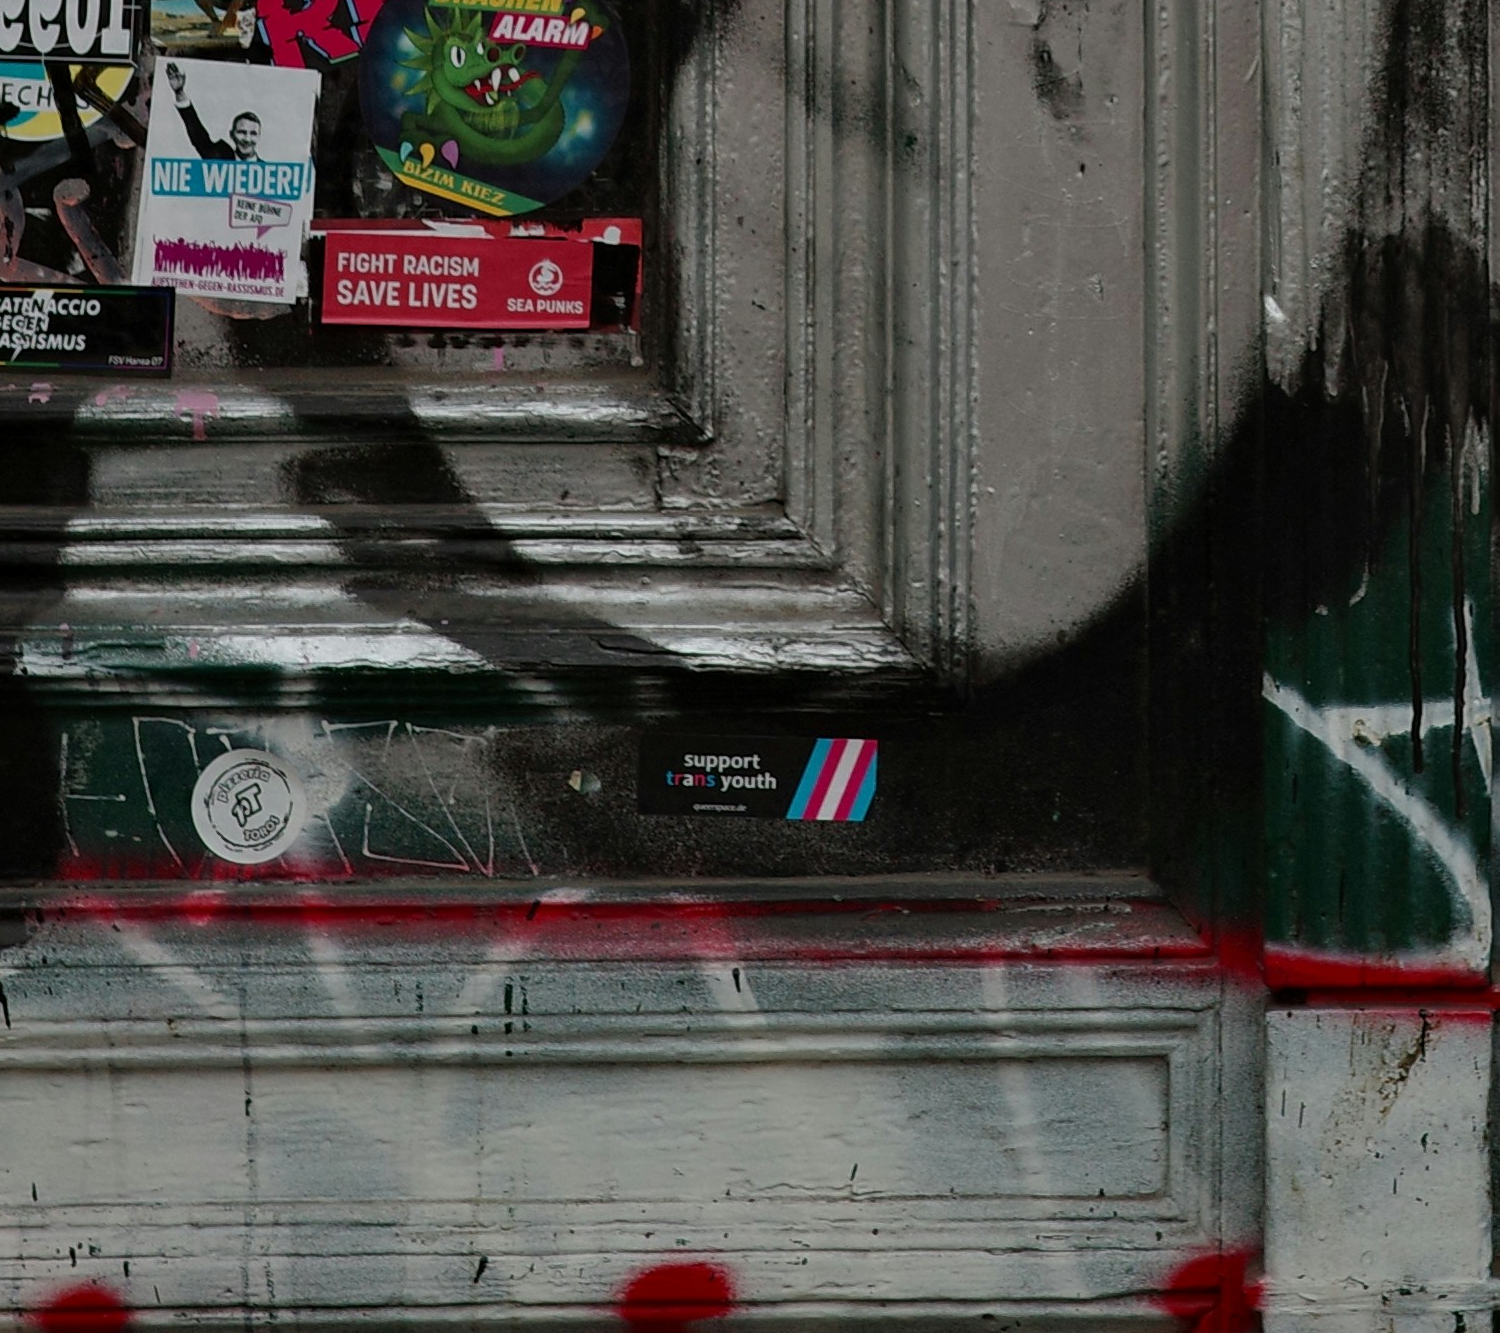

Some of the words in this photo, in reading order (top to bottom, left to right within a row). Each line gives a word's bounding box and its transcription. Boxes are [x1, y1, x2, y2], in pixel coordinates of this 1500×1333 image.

[493, 14, 591, 47] ALARM
[153, 164, 194, 189] NIE
[201, 165, 300, 196] WIEDER!
[337, 253, 398, 274] FIGHT
[402, 255, 480, 278] RACISM
[336, 280, 400, 308] SAVE
[407, 282, 478, 310] LIVES
[506, 298, 534, 313] SEA
[536, 299, 583, 314] PUNKS
[683, 750, 762, 775] support
[216, 765, 273, 807] Pizzeria
[665, 769, 716, 791] trans
[720, 770, 778, 794] youth
[243, 816, 282, 843] TOROS
